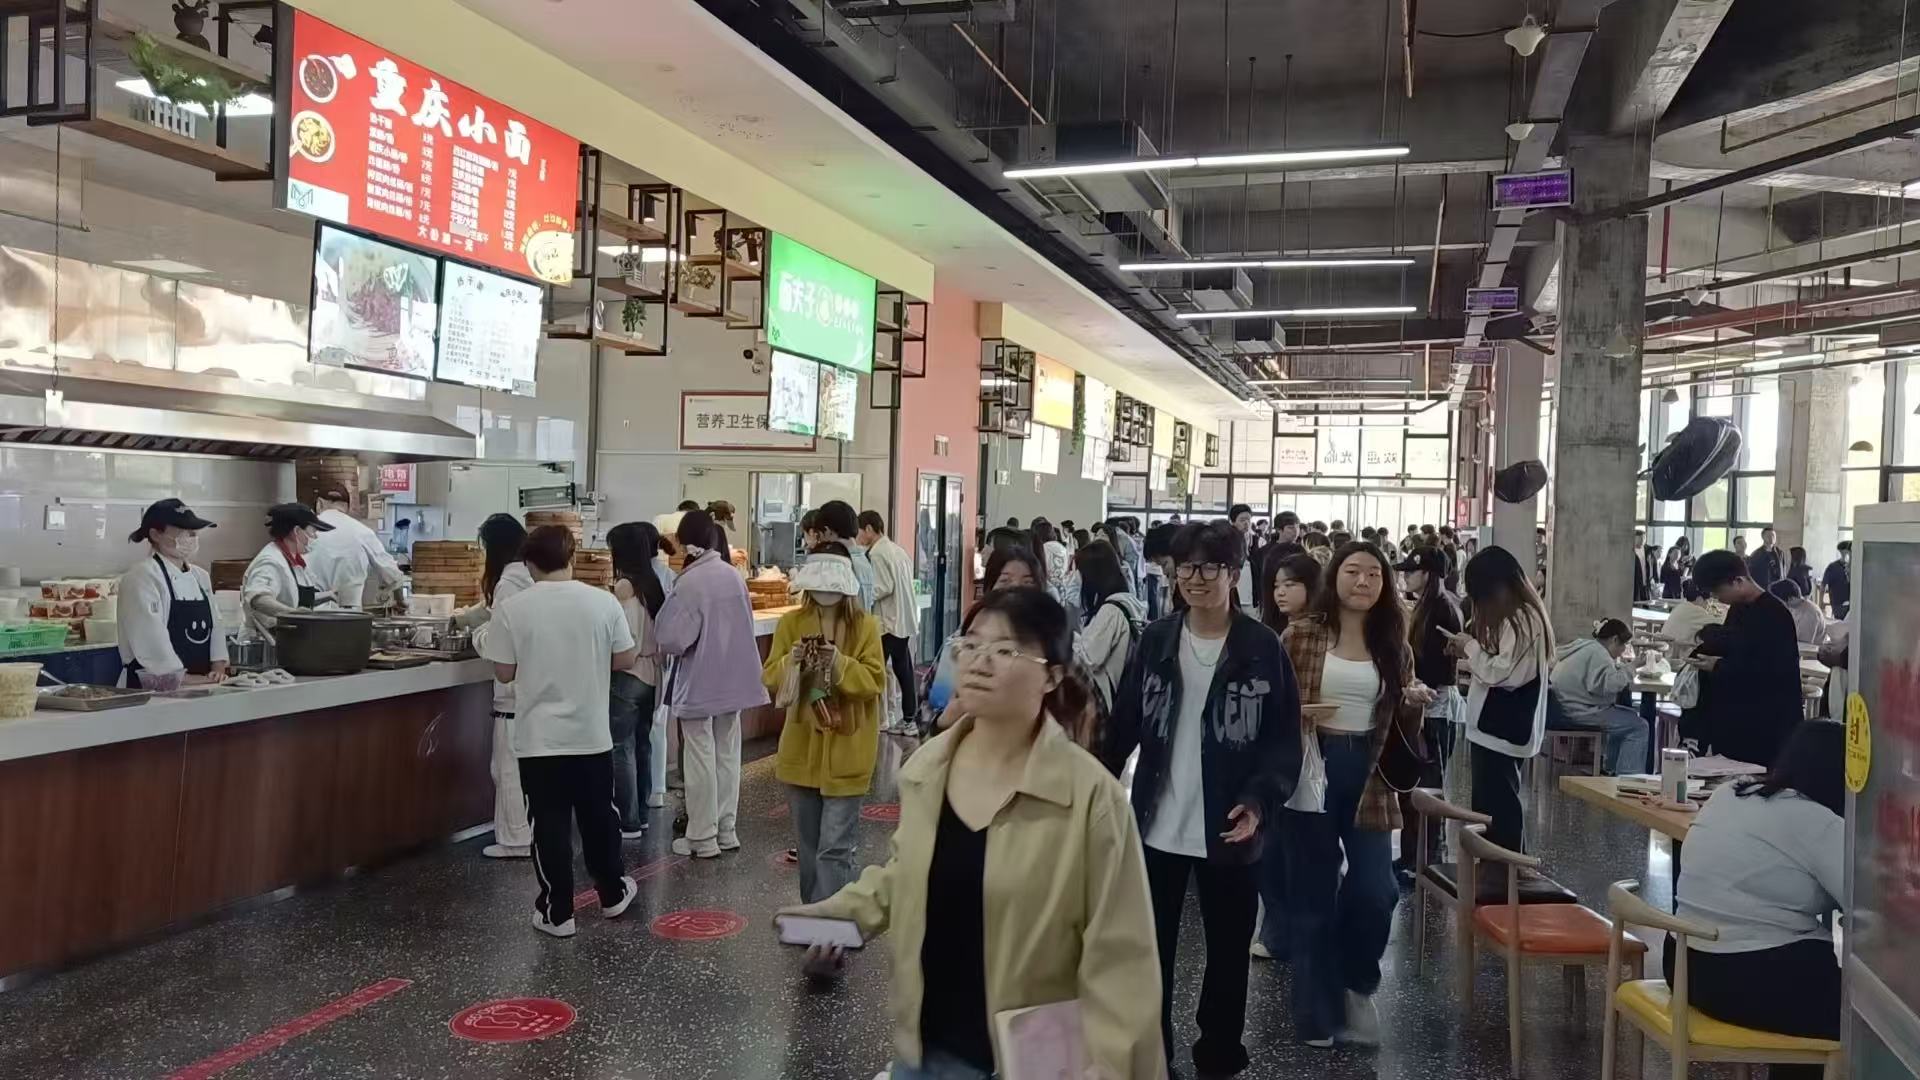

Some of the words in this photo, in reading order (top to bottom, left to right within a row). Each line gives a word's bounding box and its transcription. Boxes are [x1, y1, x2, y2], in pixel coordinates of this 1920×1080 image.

[368, 56, 532, 166] 重庆小面
[696, 413, 768, 429] 营养卫生保
